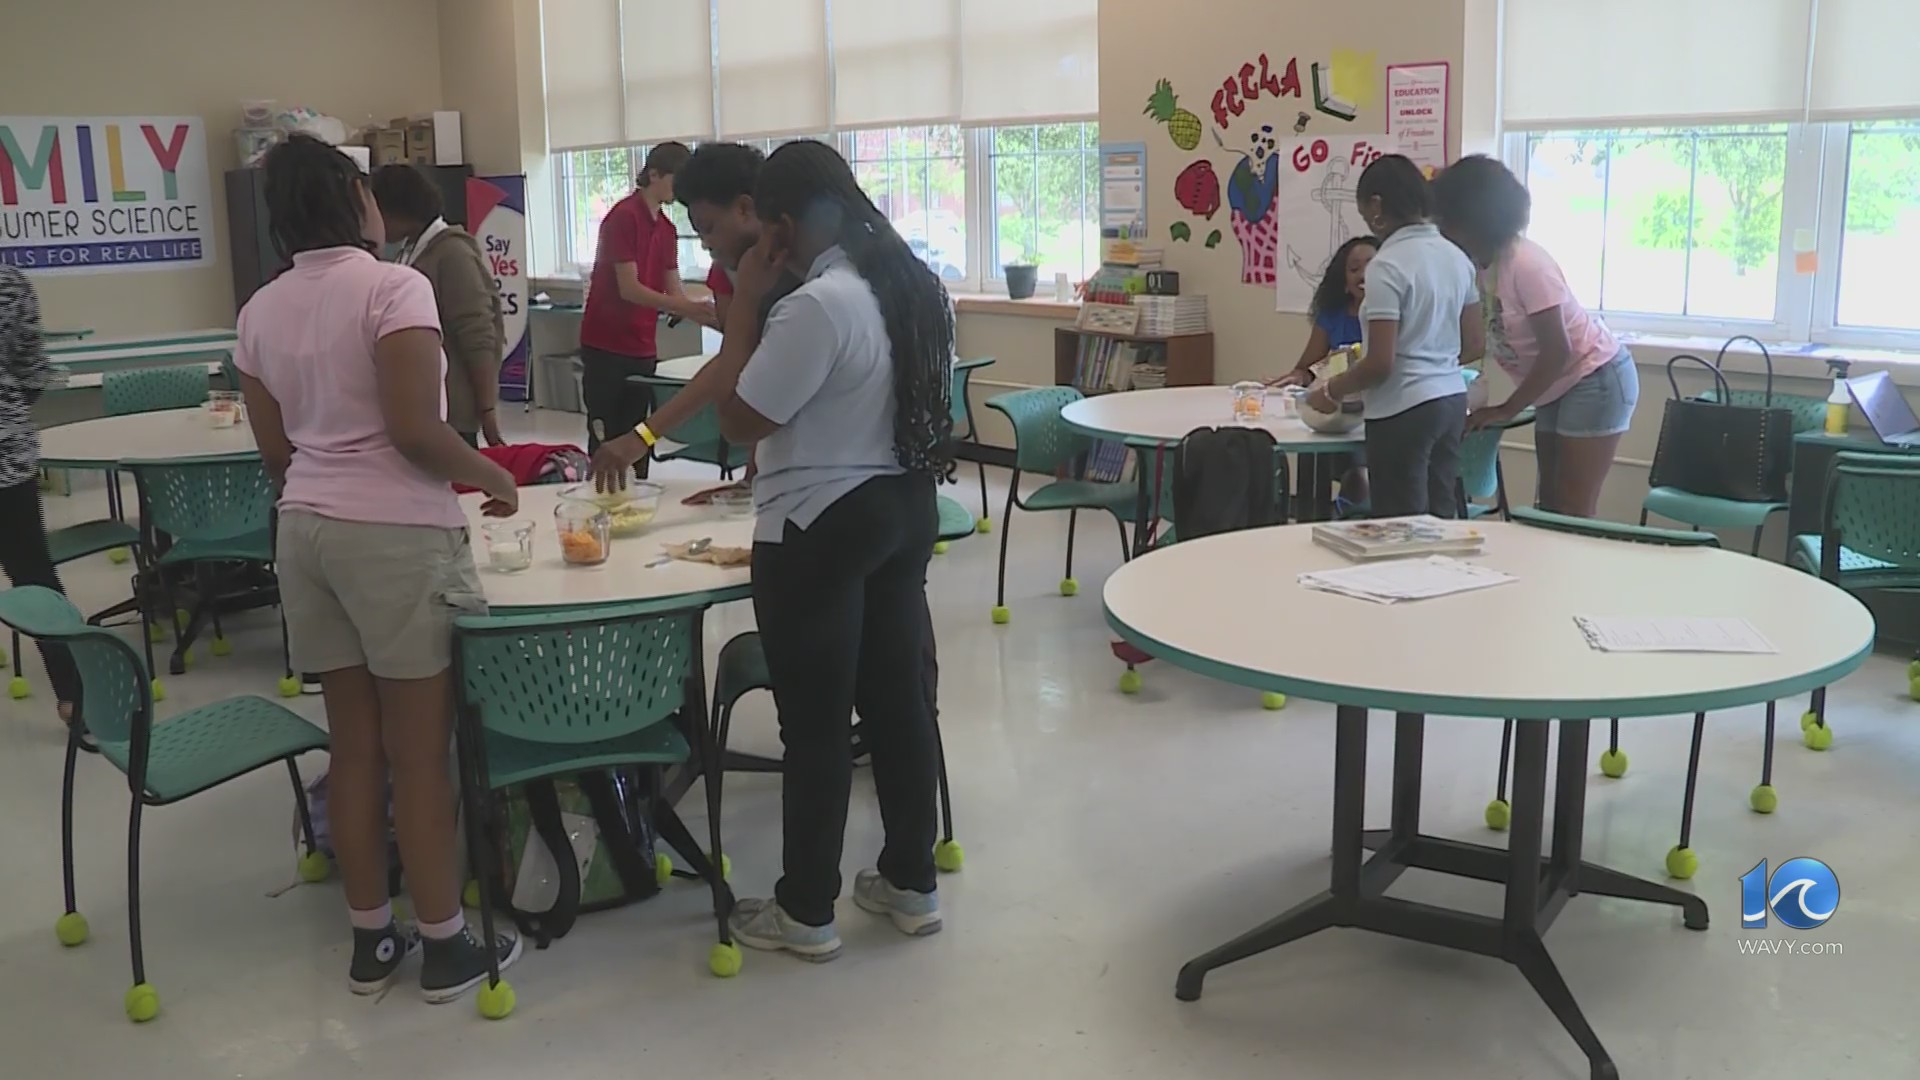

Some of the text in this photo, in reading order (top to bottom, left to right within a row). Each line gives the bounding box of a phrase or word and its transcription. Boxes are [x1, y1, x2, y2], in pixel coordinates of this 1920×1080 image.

[1394, 87, 1440, 97] EDUCATION
[1400, 108, 1433, 116] UNLOCK
[1292, 139, 1329, 172] GO
[0, 205, 199, 239] UMER SCIENCE
[47, 247, 90, 264] FOR
[102, 245, 151, 262] REAL
[163, 241, 201, 258] LIFE
[485, 234, 511, 256] Say
[489, 255, 519, 277] Yes
